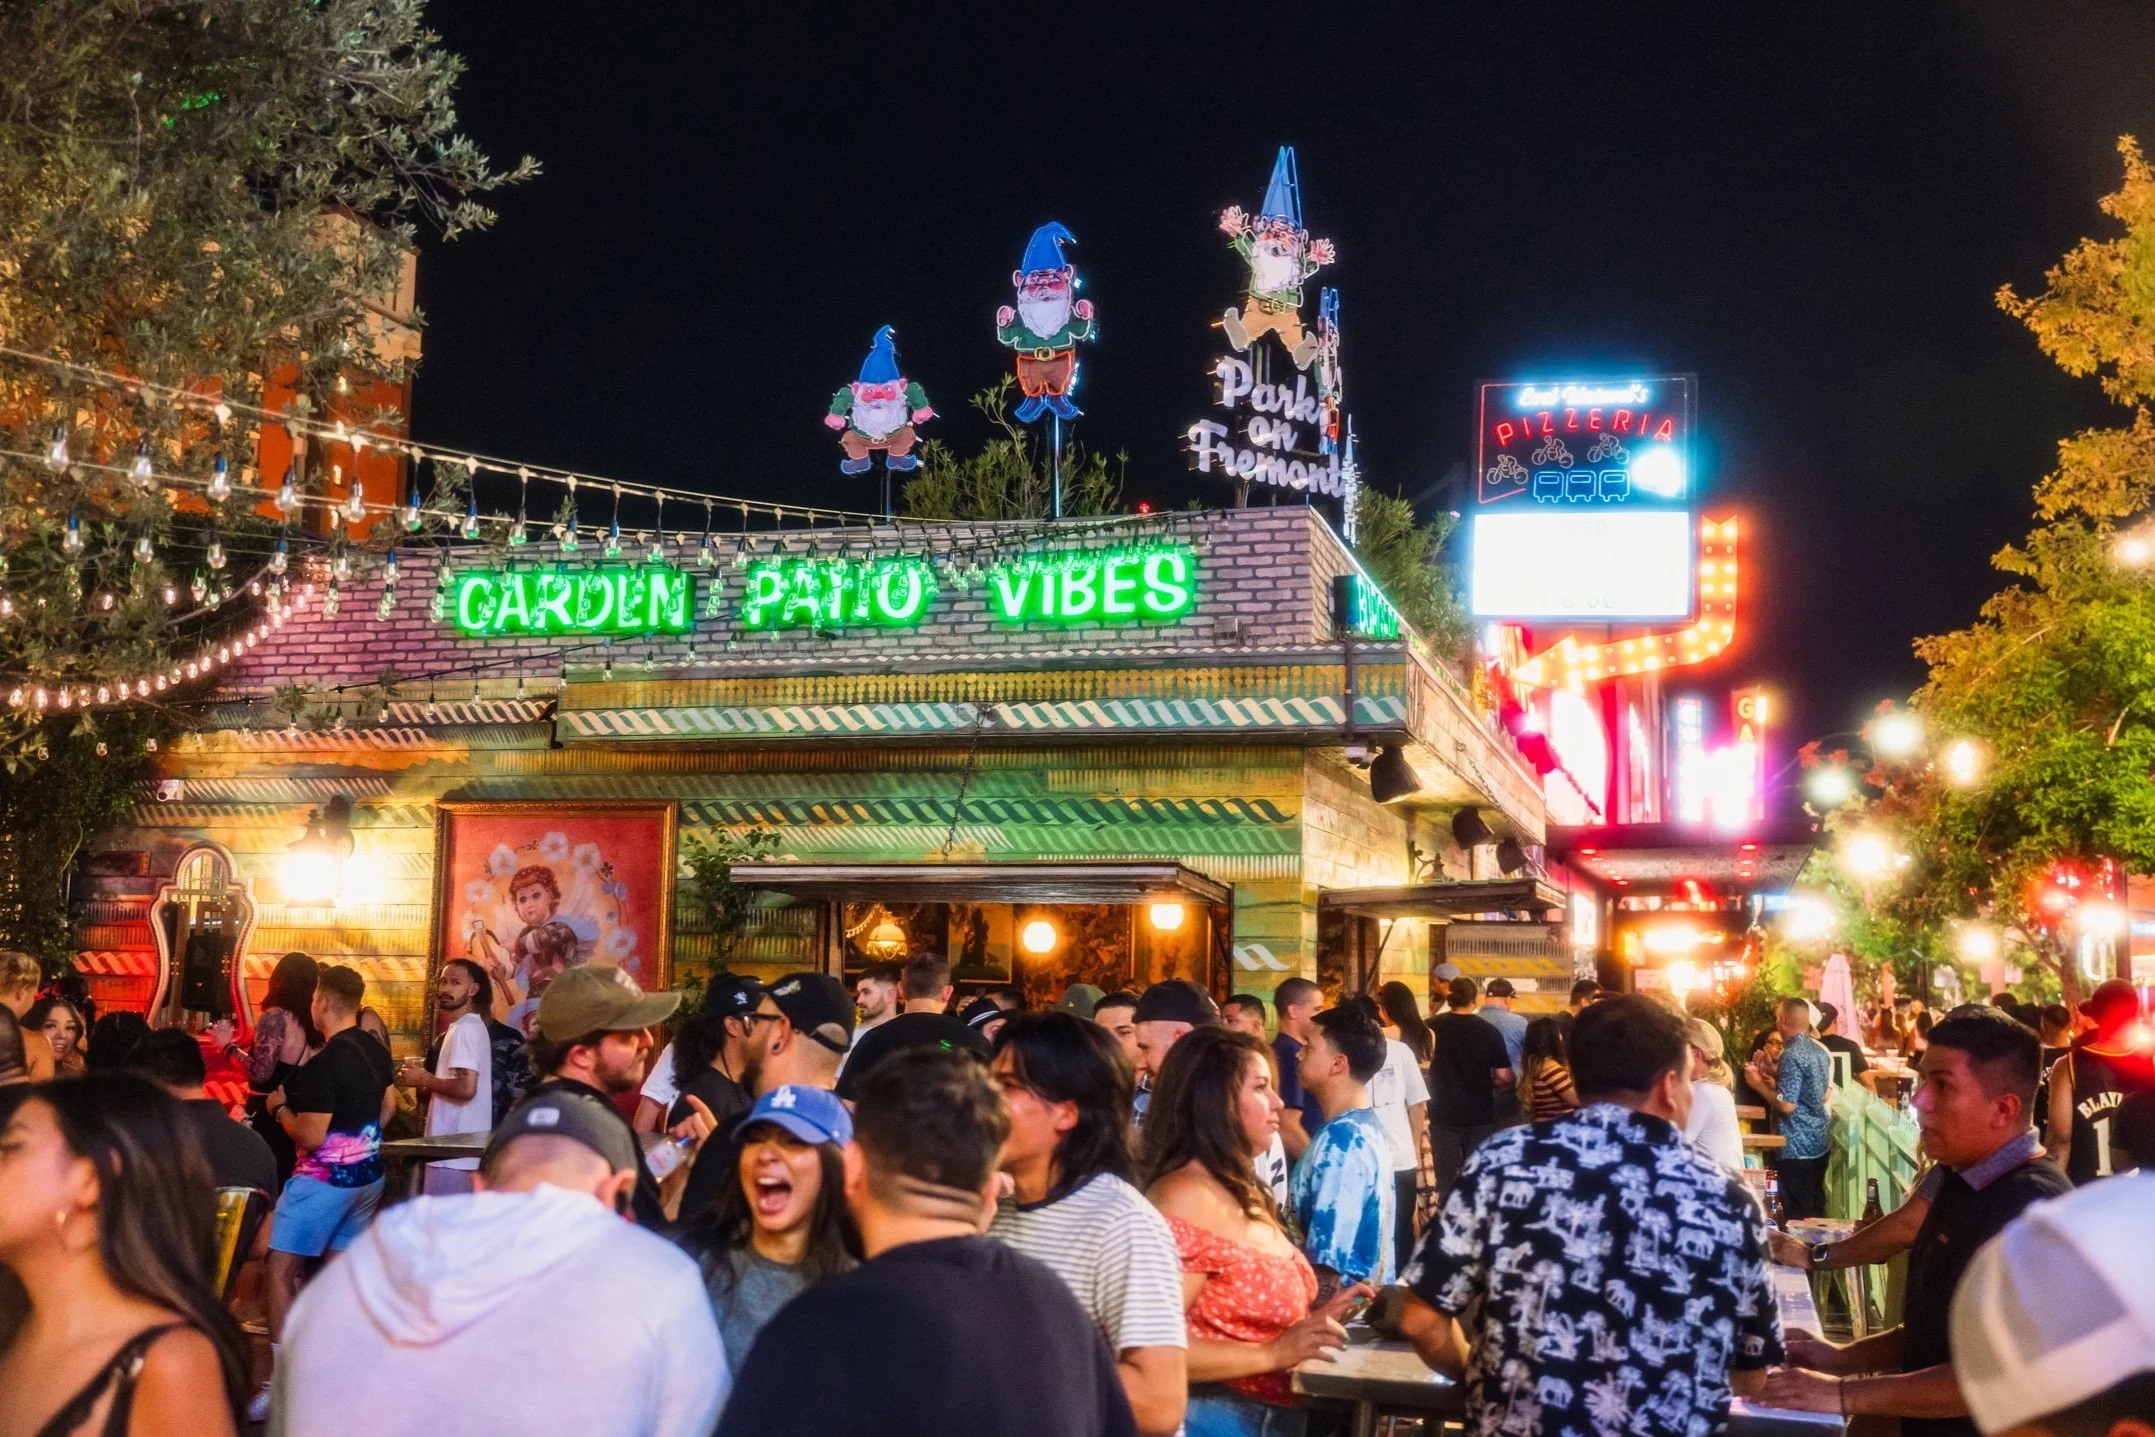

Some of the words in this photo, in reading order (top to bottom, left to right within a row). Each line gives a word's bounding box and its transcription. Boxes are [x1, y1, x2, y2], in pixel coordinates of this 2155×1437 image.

[1216, 355, 1321, 424] Park
[1188, 419, 1345, 498] Fremont
[1497, 408, 1672, 446] PIZZERIA
[459, 573, 686, 630] GARDEN
[748, 562, 922, 625] PATIO
[993, 552, 1188, 617] VIBES
[2093, 1116, 2114, 1176] 1
